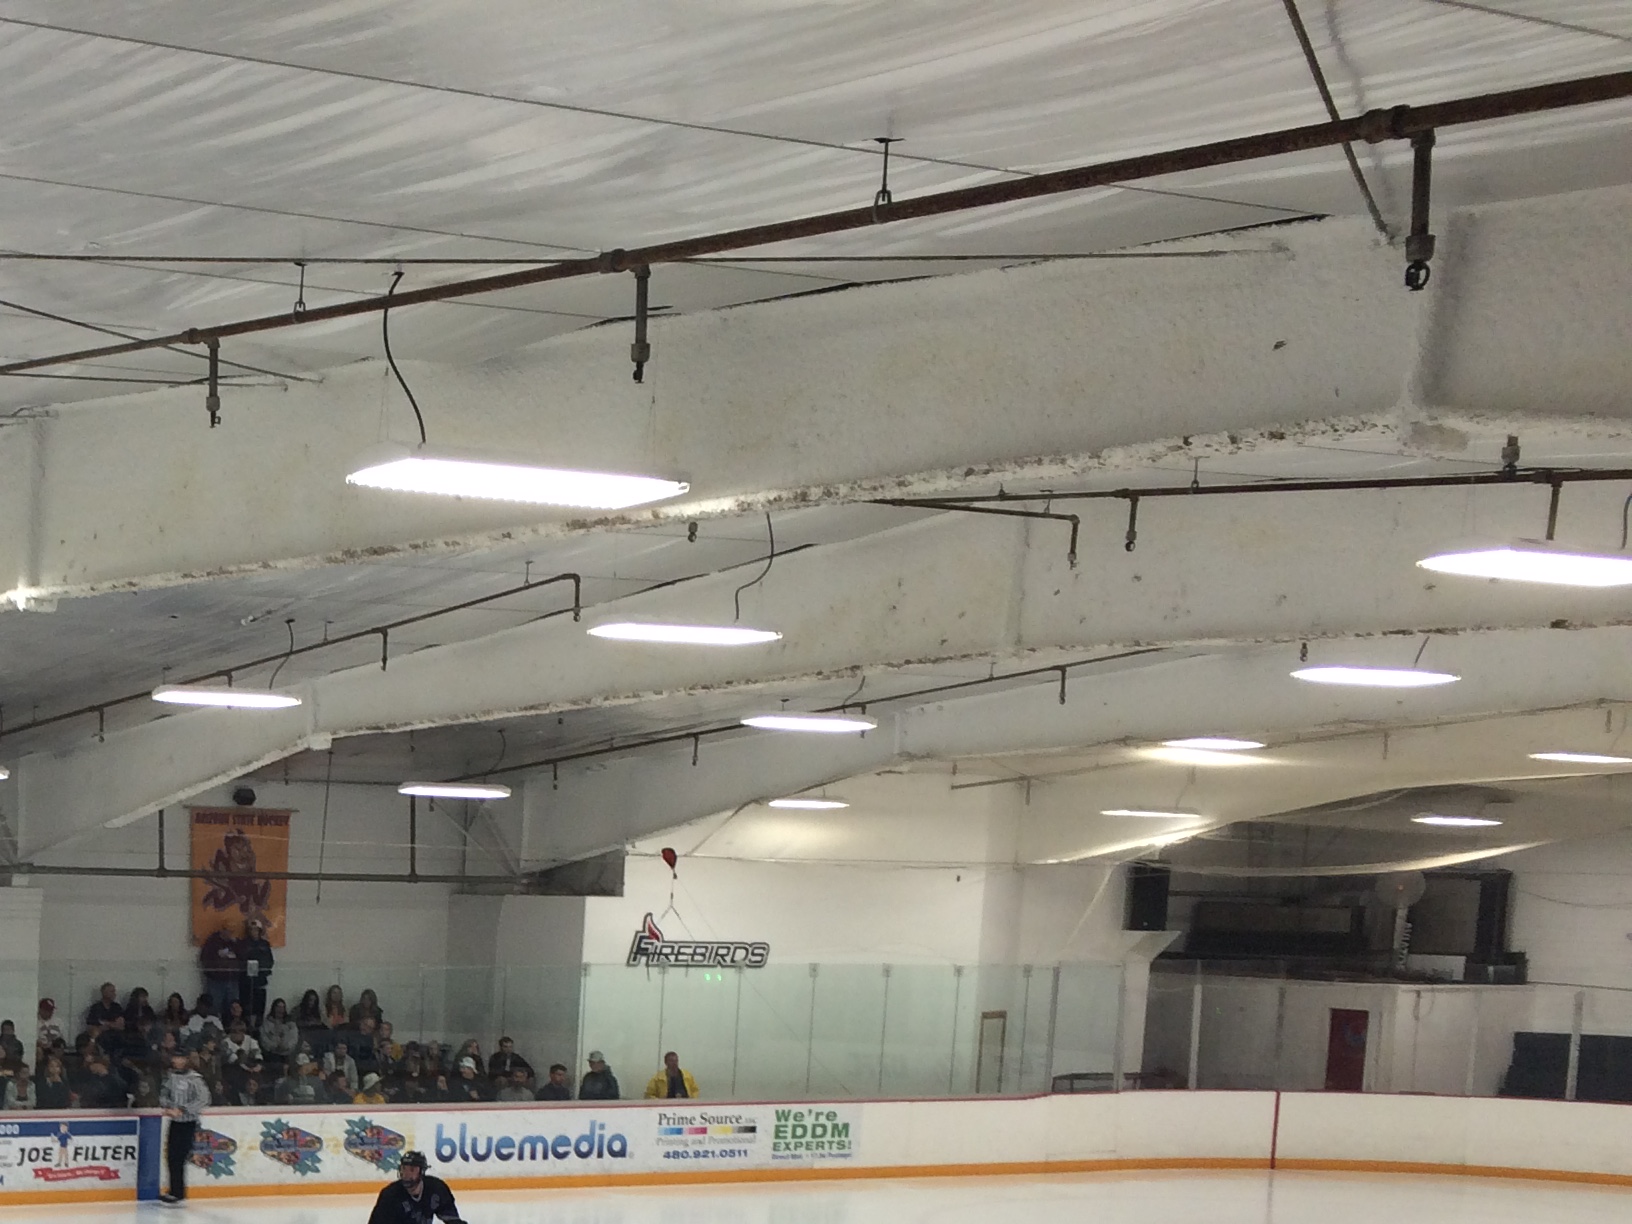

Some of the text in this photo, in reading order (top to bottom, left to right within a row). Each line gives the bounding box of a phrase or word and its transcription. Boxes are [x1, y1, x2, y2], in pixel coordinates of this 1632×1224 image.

[626, 926, 770, 968] FIREBIRDS
[658, 1112, 696, 1125] Prime
[700, 1112, 742, 1124] Source
[775, 1109, 838, 1122] We're
[774, 1123, 850, 1140] EDDM
[435, 1119, 627, 1163] bluemedia
[772, 1140, 853, 1152] EXPERTS!
[16, 1147, 54, 1166] JOE
[72, 1145, 137, 1161] FILTER
